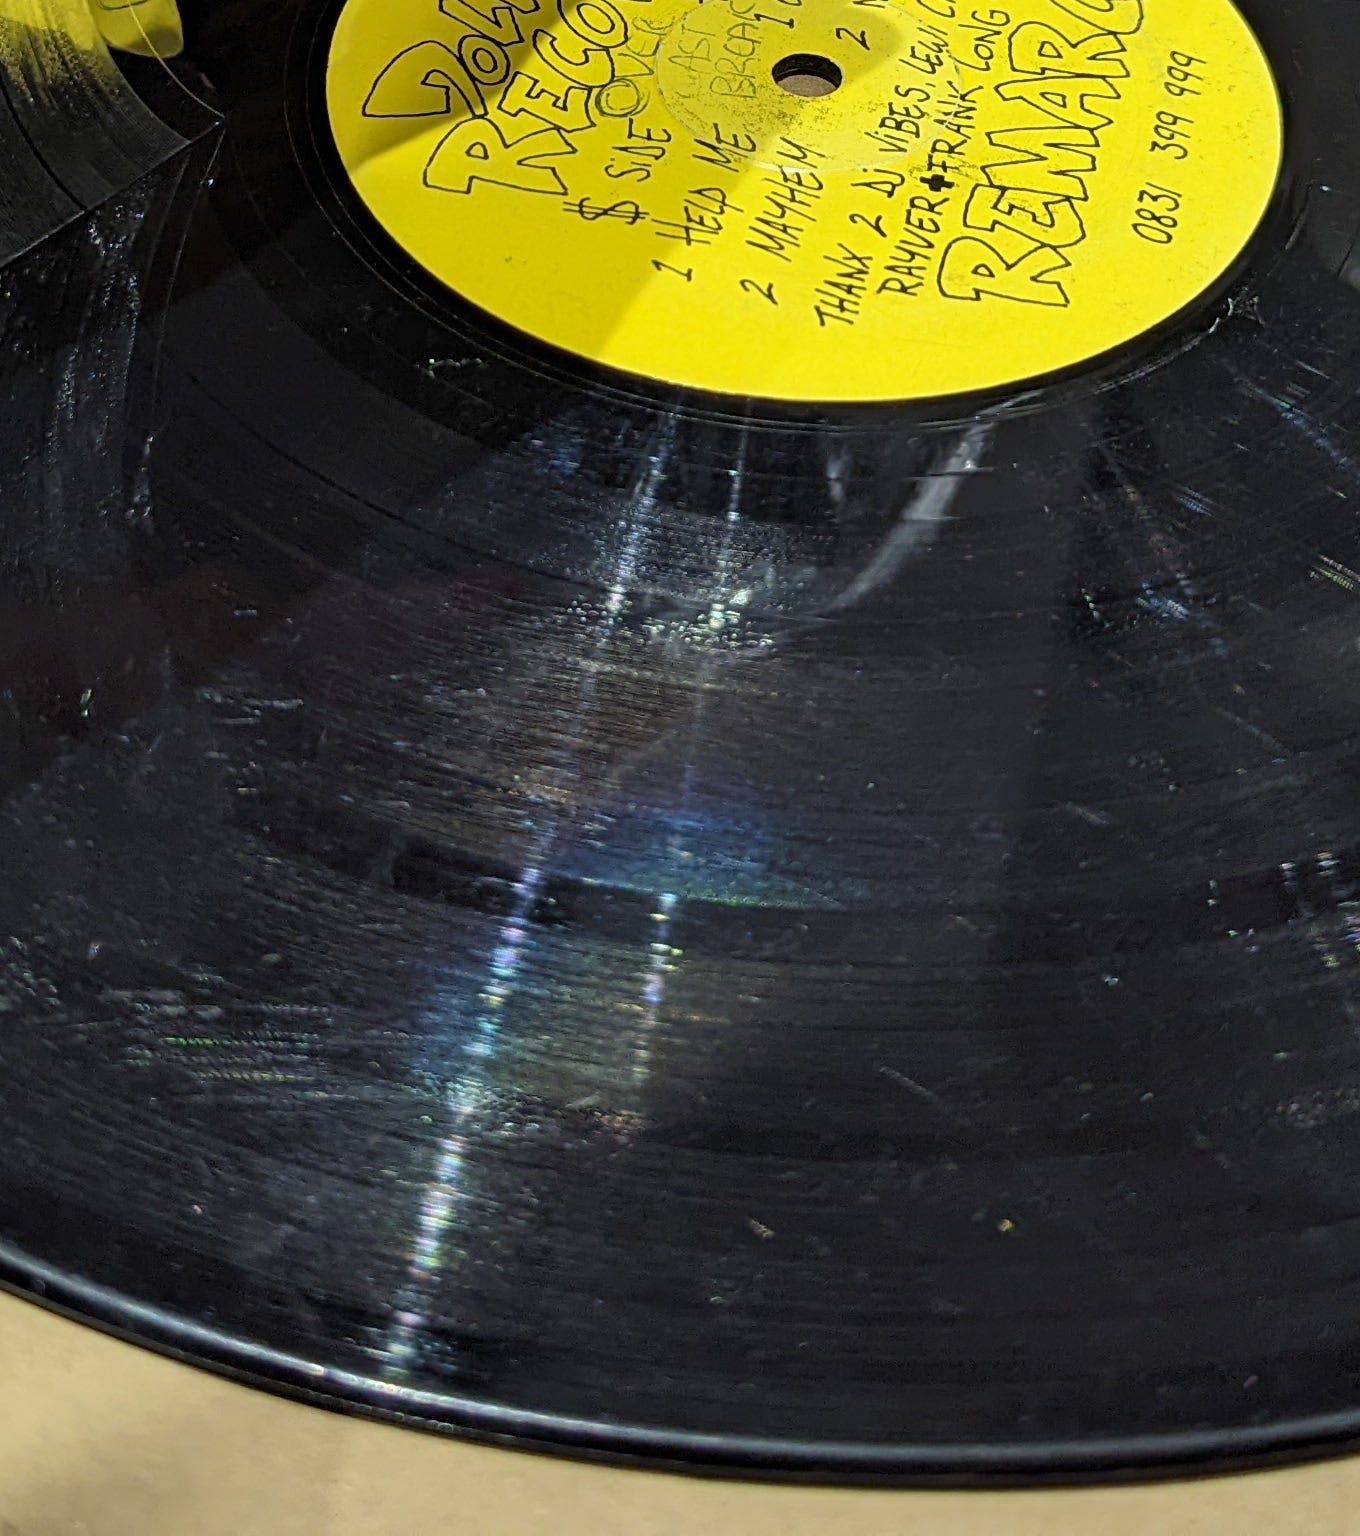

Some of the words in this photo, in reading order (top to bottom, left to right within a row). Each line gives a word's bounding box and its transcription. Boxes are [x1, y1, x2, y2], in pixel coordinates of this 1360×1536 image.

[753, 12, 794, 29] 1
[835, 27, 870, 50] 2
[1163, 50, 1207, 98] 999
[1148, 110, 1194, 160] 399
[651, 259, 693, 282] 1
[692, 123, 757, 172] ME
[746, 136, 827, 262] MAYHEM
[1132, 182, 1183, 245] 0831
[740, 278, 778, 305] 2
[814, 242, 873, 327] THANX
[849, 212, 887, 238] 2
